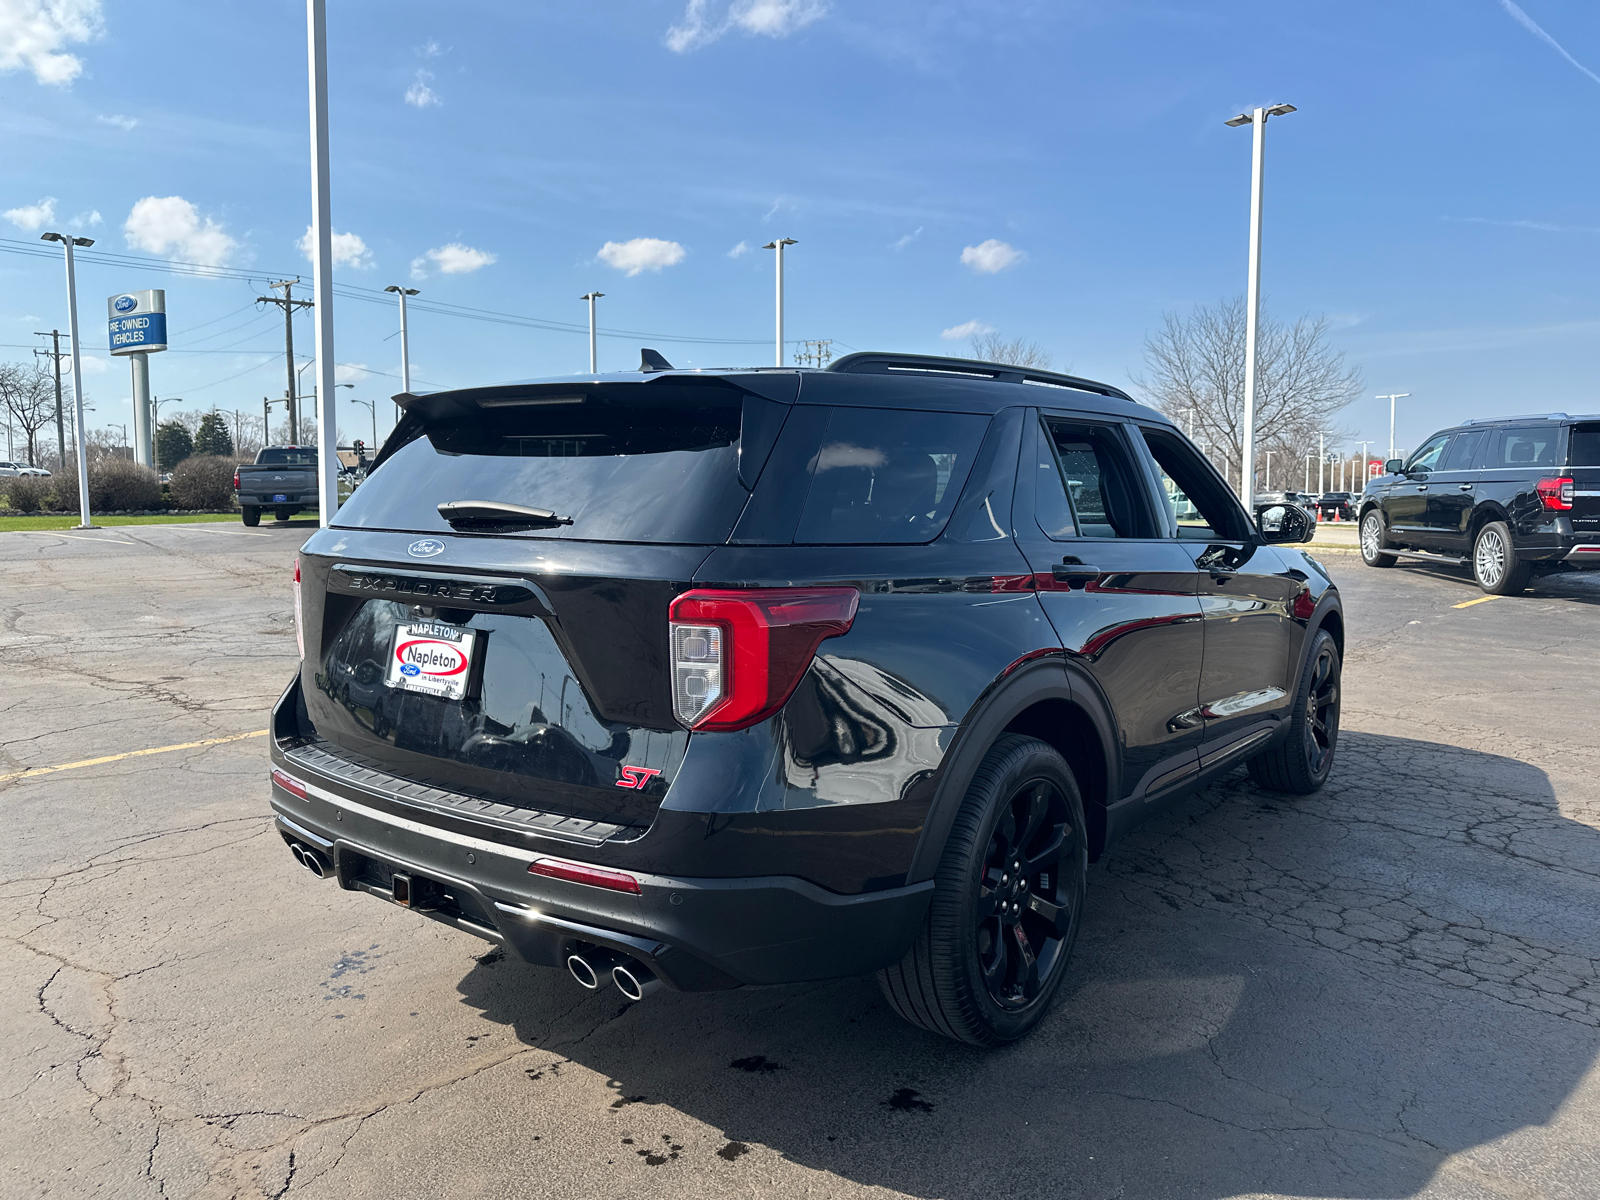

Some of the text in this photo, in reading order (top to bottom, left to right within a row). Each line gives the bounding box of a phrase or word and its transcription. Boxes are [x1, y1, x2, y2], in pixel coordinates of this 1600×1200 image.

[110, 318, 149, 332] PRE-OWNED
[113, 331, 144, 344] VEHICLES
[349, 576, 497, 602] EXPLORER
[411, 624, 457, 640] NAPLETON
[407, 646, 456, 668] Napleton
[402, 665, 418, 675] Ford
[428, 676, 459, 686] Libertyville
[615, 765, 661, 789] ST
